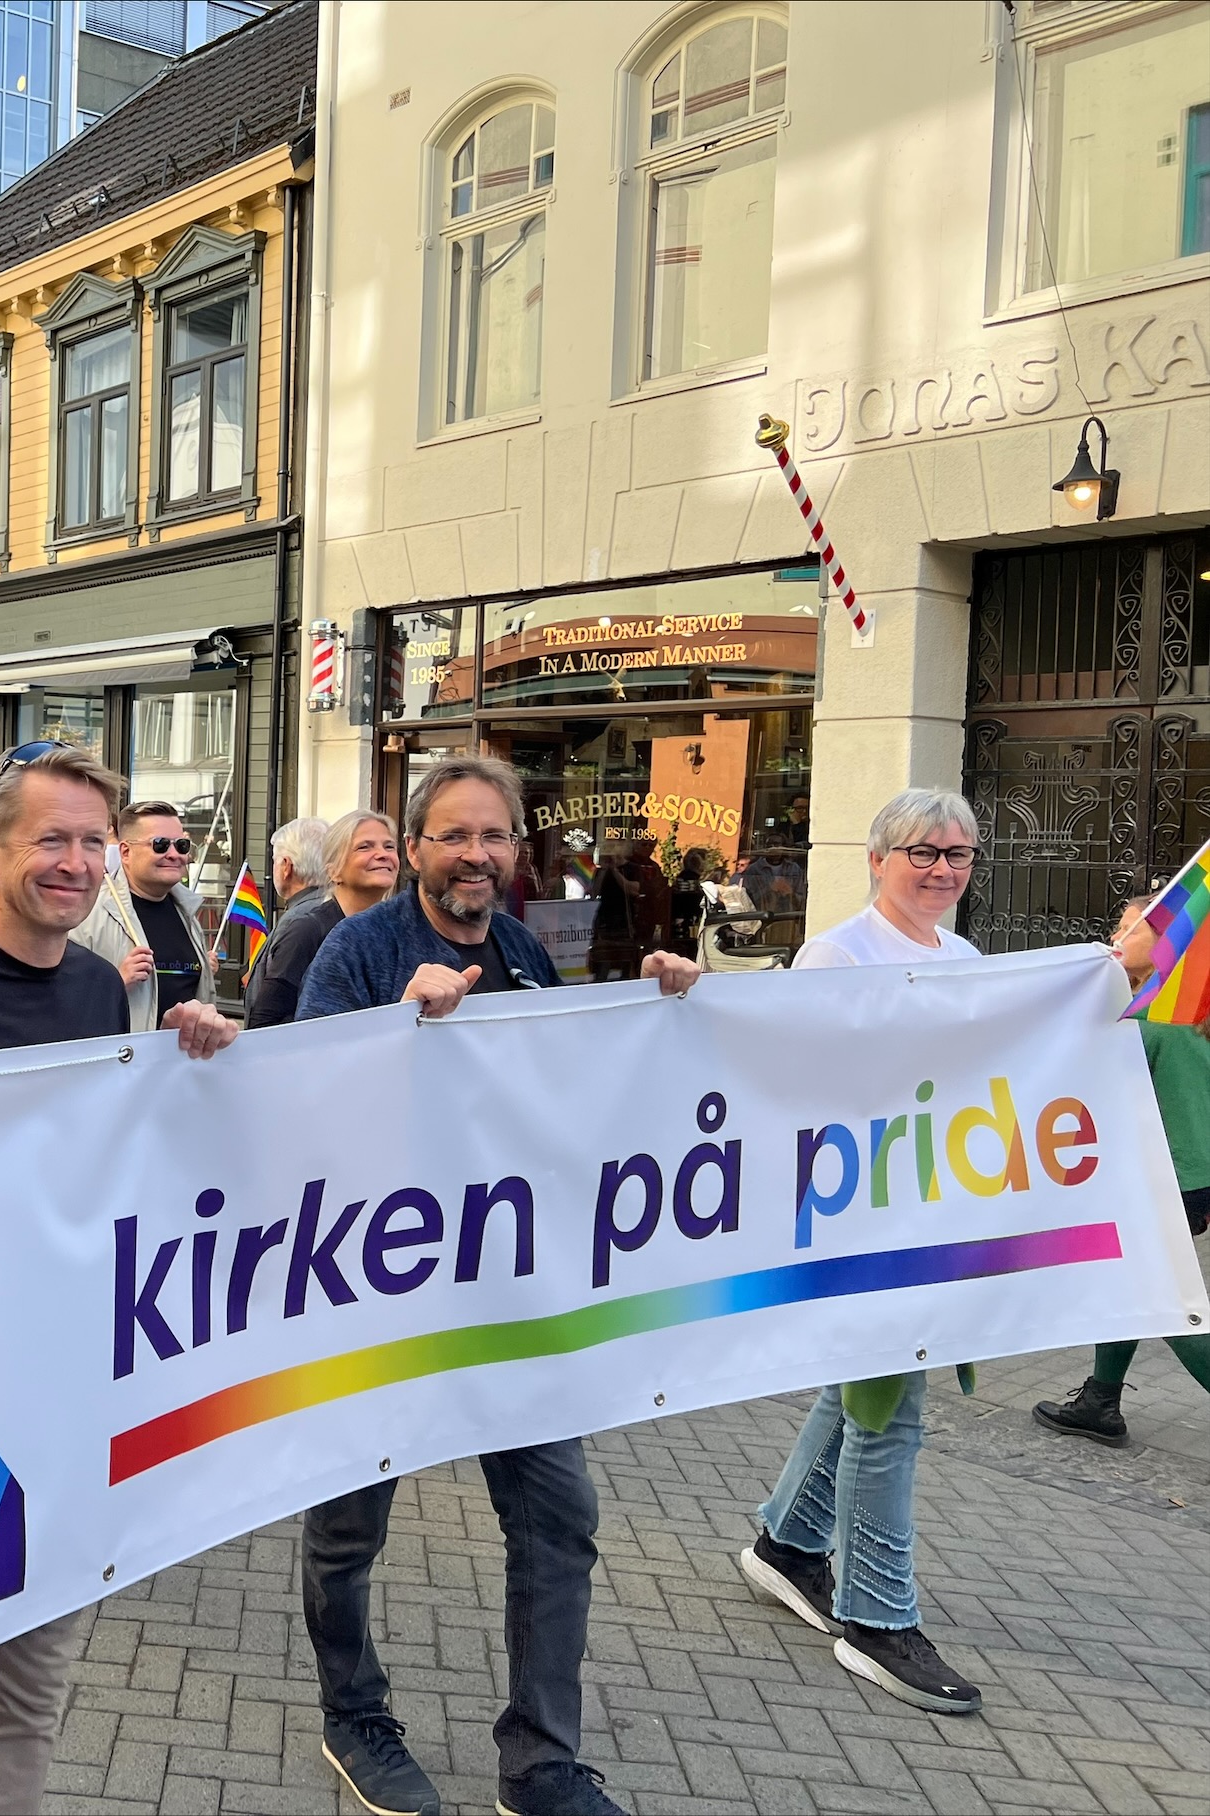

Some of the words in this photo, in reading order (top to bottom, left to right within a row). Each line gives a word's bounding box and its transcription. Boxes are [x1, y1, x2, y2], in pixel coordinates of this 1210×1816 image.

[802, 347, 1060, 451] JONAS
[1086, 314, 1210, 404] KA
[543, 627, 657, 646] TRADITIONAL
[662, 612, 743, 635] SERVICE
[406, 640, 450, 659] SINCE
[539, 656, 559, 675] IN
[562, 654, 577, 673] A
[580, 650, 658, 673] MODERN
[661, 643, 746, 666] MANNER
[410, 665, 445, 685] 1985
[534, 793, 741, 837] BARBER&SONS
[604, 827, 628, 840] EST
[631, 828, 657, 841] 1985
[113, 1177, 534, 1381] kirken
[592, 1091, 743, 1289] på
[794, 1078, 1099, 1250] pride
